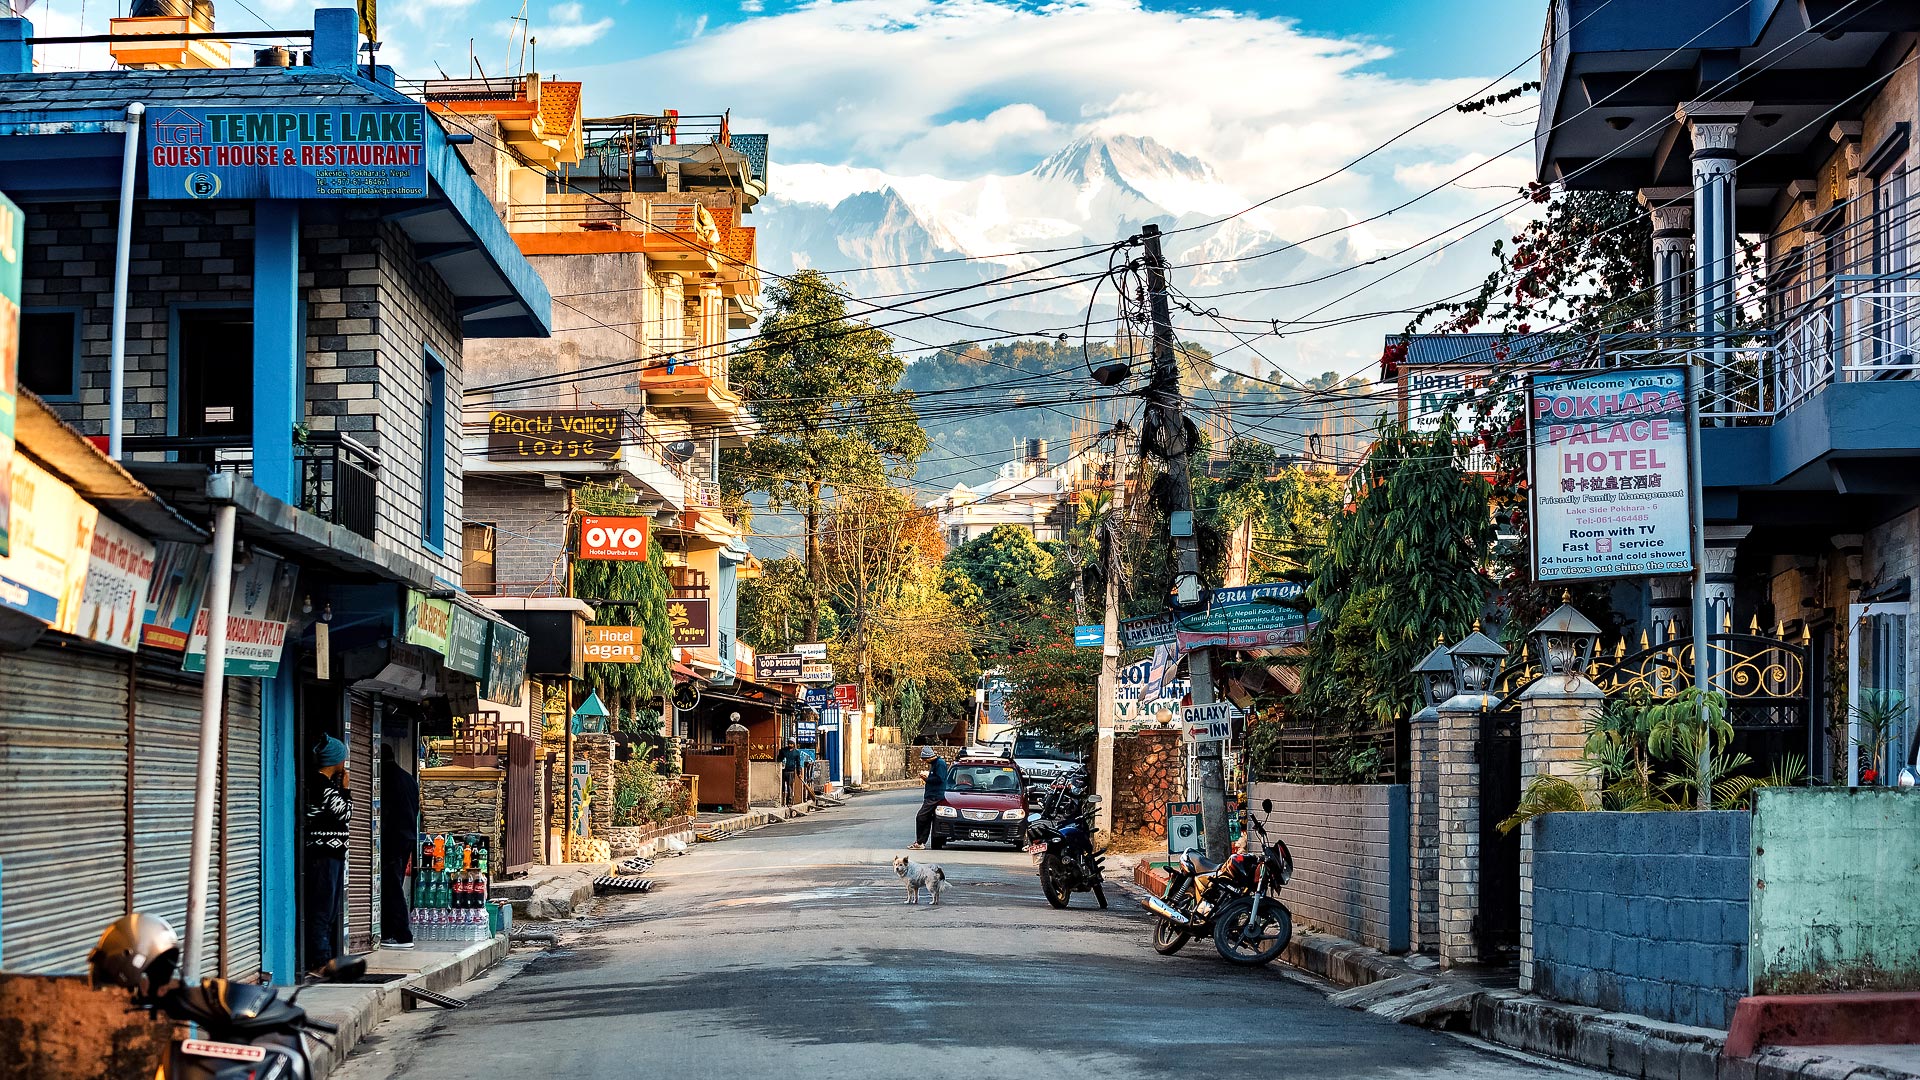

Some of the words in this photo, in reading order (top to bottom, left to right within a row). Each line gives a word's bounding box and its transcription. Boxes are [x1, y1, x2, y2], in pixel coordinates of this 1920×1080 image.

[205, 113, 333, 143] TEMPLE
[340, 112, 423, 143] LAKE
[153, 146, 213, 167] GUEST
[216, 146, 280, 167] HOUSE
[283, 148, 297, 166] &
[301, 144, 423, 166] RESTAURANT
[1413, 374, 1463, 389] HOTEL
[1544, 382, 1564, 391] We
[1567, 380, 1625, 390] Welcome
[1629, 377, 1653, 387] You
[1656, 376, 1673, 385] To
[1534, 391, 1686, 420] POKHARA
[494, 416, 553, 434] Placid
[559, 416, 617, 435] Valley
[1549, 419, 1669, 446] PALACE
[518, 439, 594, 458] Lodge
[1564, 449, 1666, 474] HOTEL
[1539, 495, 1581, 505] Friendly
[1582, 493, 1617, 503] Family
[1618, 489, 1685, 501] Management
[1566, 507, 1587, 515] Lake
[1610, 504, 1645, 512] Pokhara
[586, 527, 643, 549] OYO
[1569, 528, 1605, 538] Room
[1608, 526, 1635, 536] with
[1639, 525, 1656, 534] TV
[1562, 542, 1590, 552] Fast
[1619, 539, 1665, 549] service
[1541, 556, 1554, 565] 24
[1556, 555, 1584, 564] hours
[1586, 553, 1602, 562] hot
[1605, 552, 1624, 561] and
[1626, 550, 1648, 560] cold
[1650, 549, 1686, 558] shower
[1540, 566, 1559, 576] Our
[1561, 565, 1592, 574] views
[1594, 563, 1612, 573] out
[1615, 560, 1644, 571] shine
[1646, 559, 1664, 569] the
[1666, 558, 1689, 569] rest
[1234, 608, 1257, 617] Nepali
[599, 630, 634, 642] Hotel
[680, 628, 705, 636] Valley
[1125, 629, 1149, 641] LAKE
[1184, 706, 1227, 722] GALAXY
[1209, 722, 1229, 737] INN
[572, 764, 588, 775] OTEL
